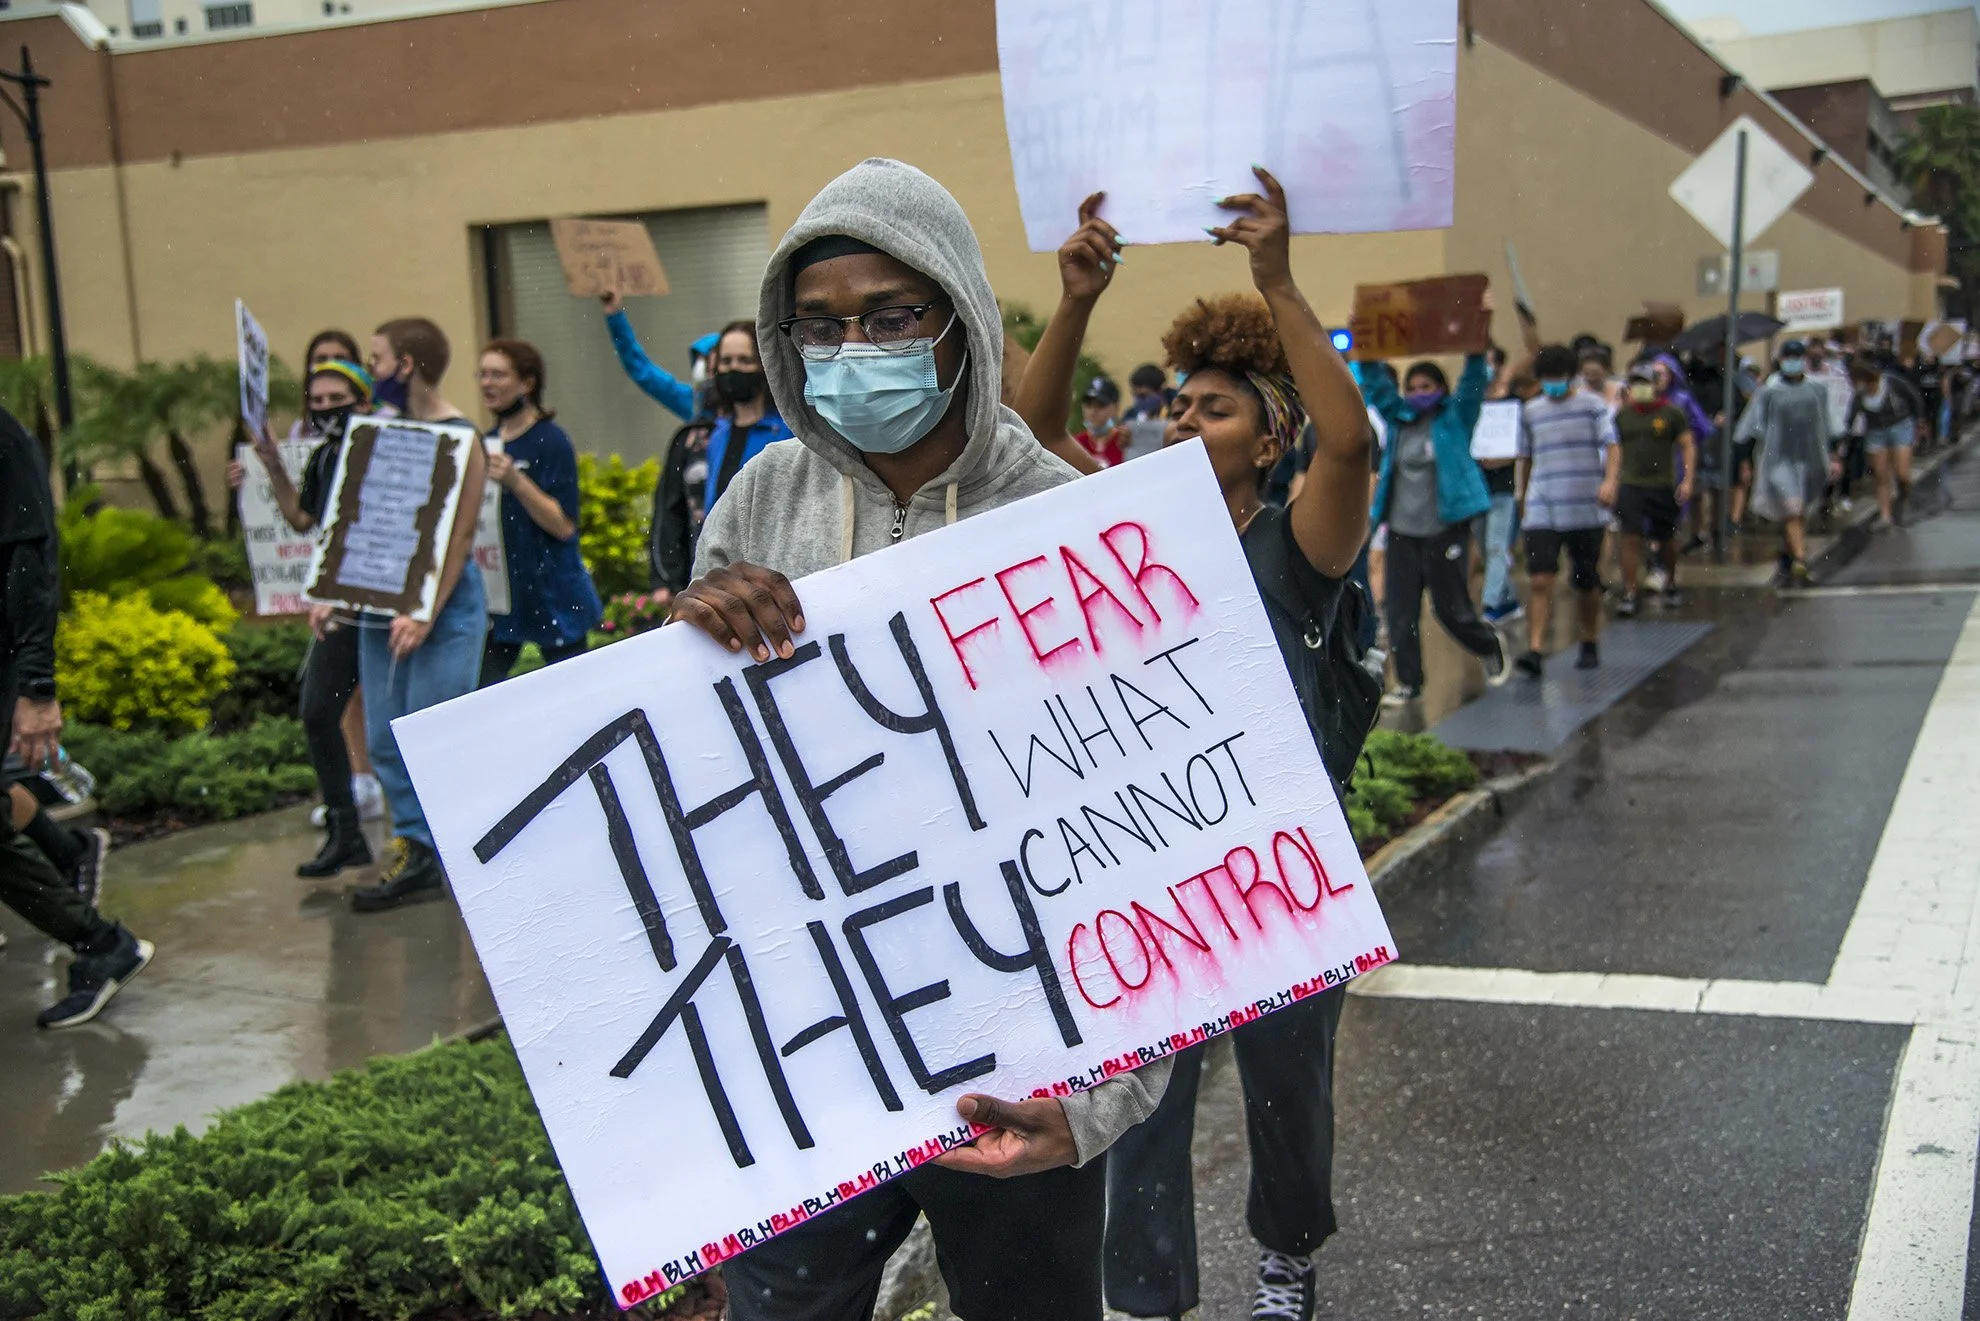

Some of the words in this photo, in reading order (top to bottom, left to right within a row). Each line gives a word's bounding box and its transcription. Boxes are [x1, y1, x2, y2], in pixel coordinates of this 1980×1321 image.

[930, 521, 1200, 690] FEAR
[473, 611, 987, 972] THEY
[988, 638, 1214, 797] WHAT
[1020, 732, 1256, 897] CANNOT
[1068, 827, 1354, 1009] CONTROL
[610, 860, 1083, 1168] THEY
[622, 1271, 664, 1304] BLM
[662, 1251, 704, 1285] BLM
[701, 1233, 745, 1265] BLM
[737, 1219, 773, 1249] BLM
[771, 1204, 807, 1232] BLM
[803, 1187, 843, 1216] BLM
[837, 1170, 876, 1199] BLM
[873, 1151, 911, 1184] BLM
[908, 1138, 943, 1167] BLM
[938, 1125, 972, 1151] BLM
[1067, 1066, 1105, 1092] BLM
[1102, 1050, 1141, 1076] BLM
[1137, 1038, 1173, 1063] BLM
[1171, 1026, 1206, 1050] BLM
[1202, 1015, 1232, 1038] BLM
[1229, 1005, 1260, 1026] BLM
[1256, 990, 1292, 1015] BLM
[1291, 975, 1325, 1000] BLM
[1324, 961, 1357, 985] BLM
[1355, 946, 1390, 972] BLM
